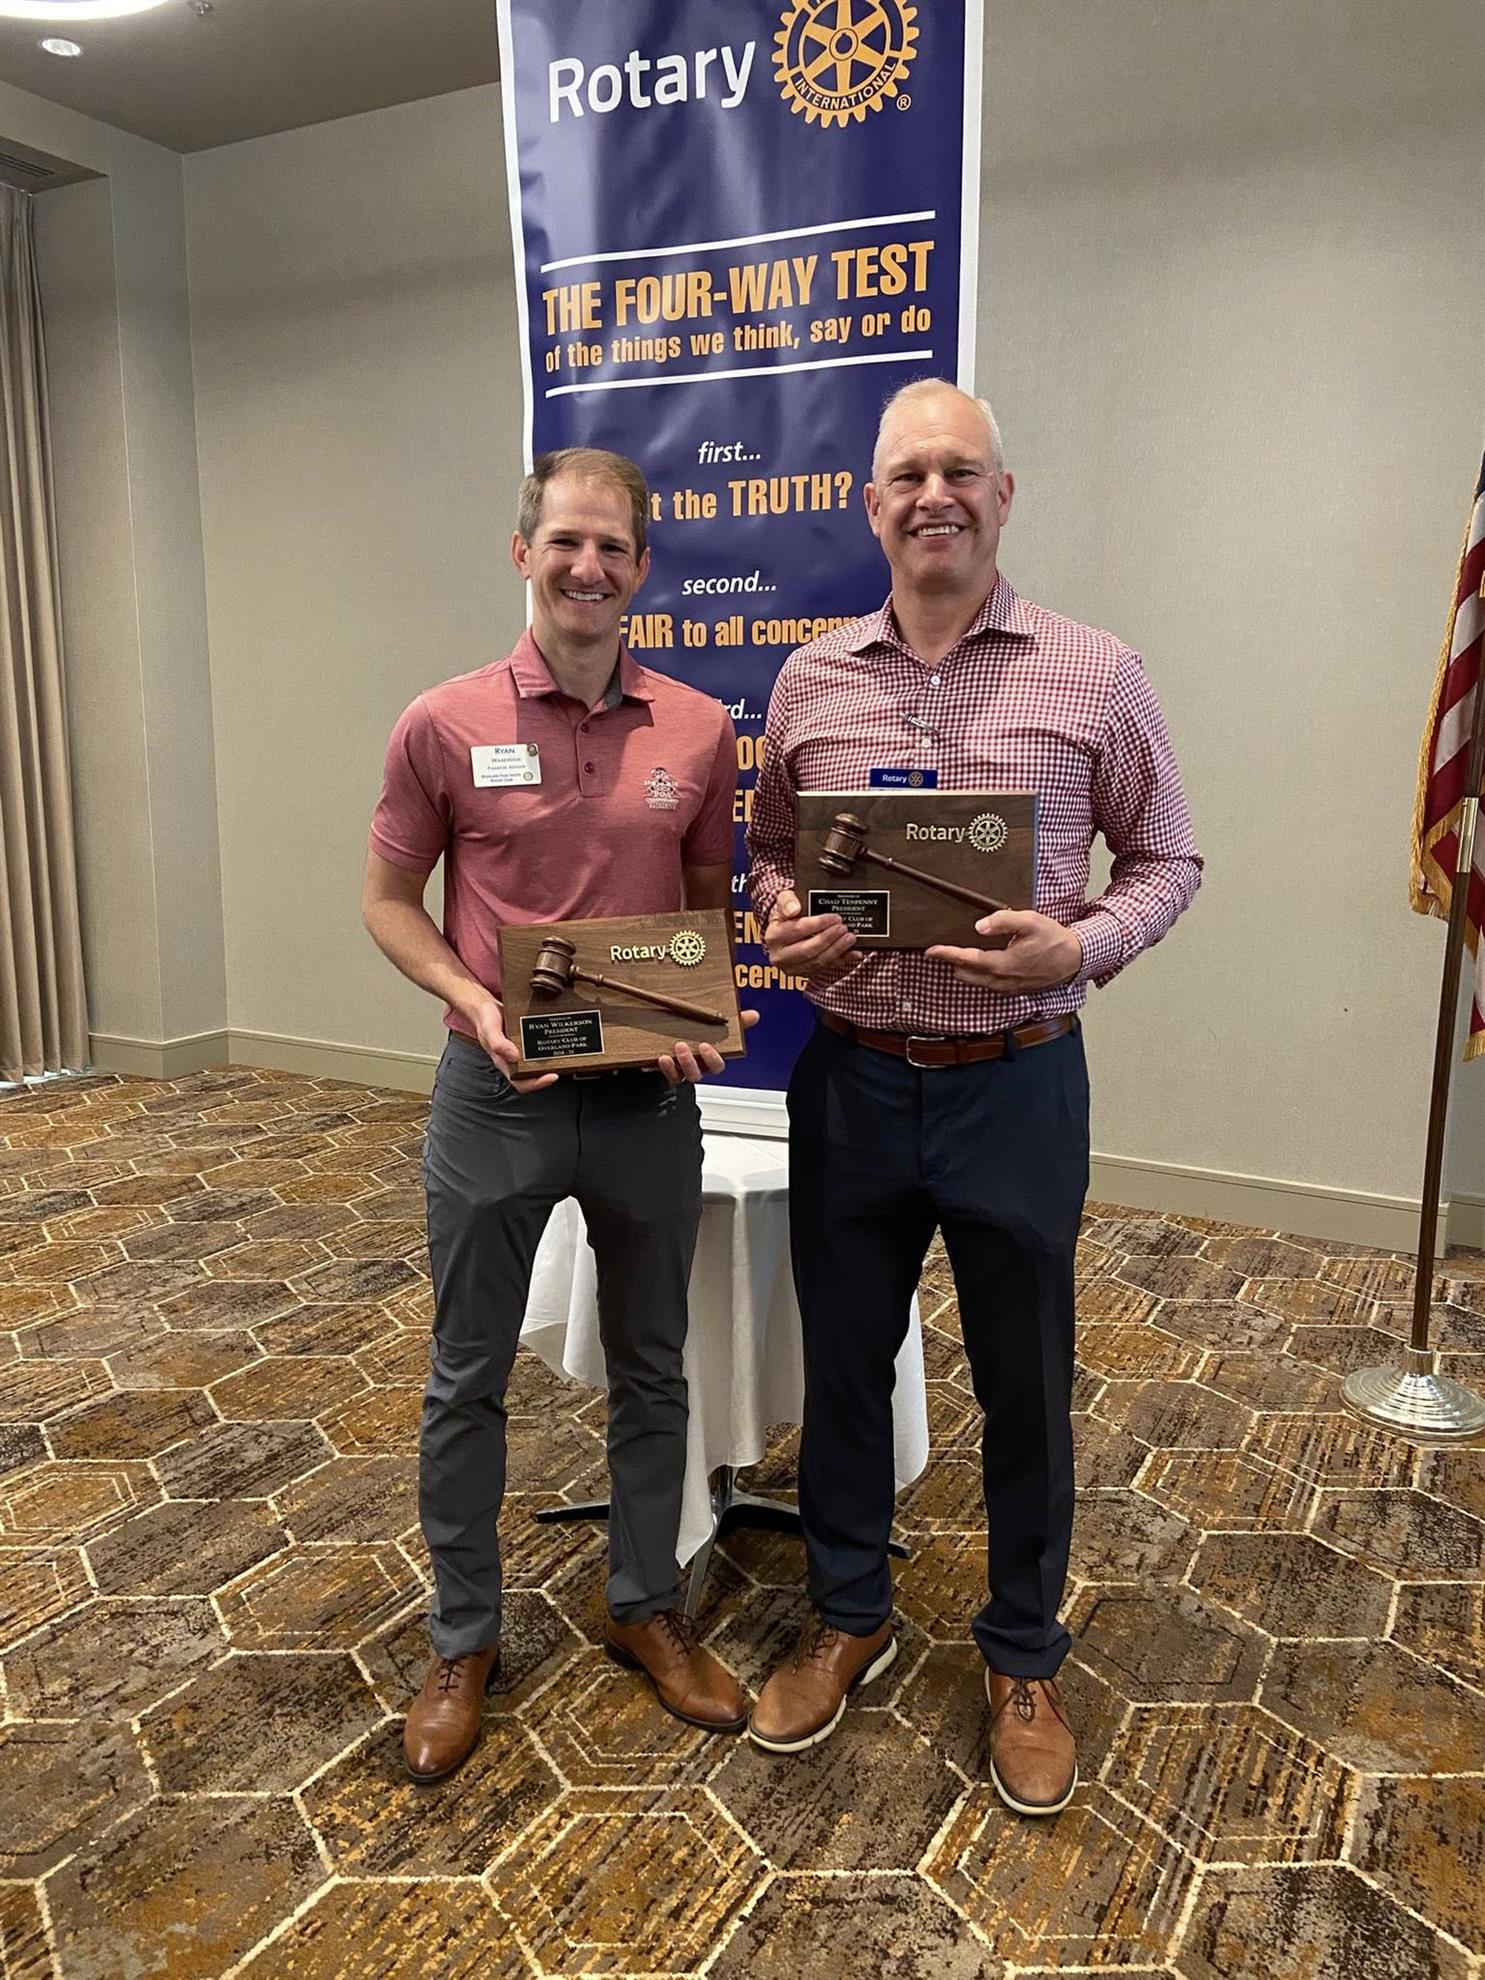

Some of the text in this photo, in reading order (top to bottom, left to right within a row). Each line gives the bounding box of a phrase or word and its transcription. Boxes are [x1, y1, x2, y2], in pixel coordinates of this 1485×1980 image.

[549, 41, 756, 123] Rotary
[795, 61, 896, 110] INTERNATIONAL
[542, 240, 935, 336] THE FOUR-WAY TEST
[545, 305, 932, 373] of the things we think, say or do
[698, 441, 761, 464] first...
[673, 489, 718, 520] the
[728, 471, 853, 517] TRUTH?
[681, 570, 777, 595] second...
[682, 615, 708, 647] to
[714, 615, 744, 646] all
[882, 774, 907, 784] Rotary
[906, 823, 965, 843] Rotary
[610, 944, 666, 961] Rotary
[528, 1019, 593, 1031] RYAN WILKERSON
[537, 1043, 571, 1051] OVERLAND
